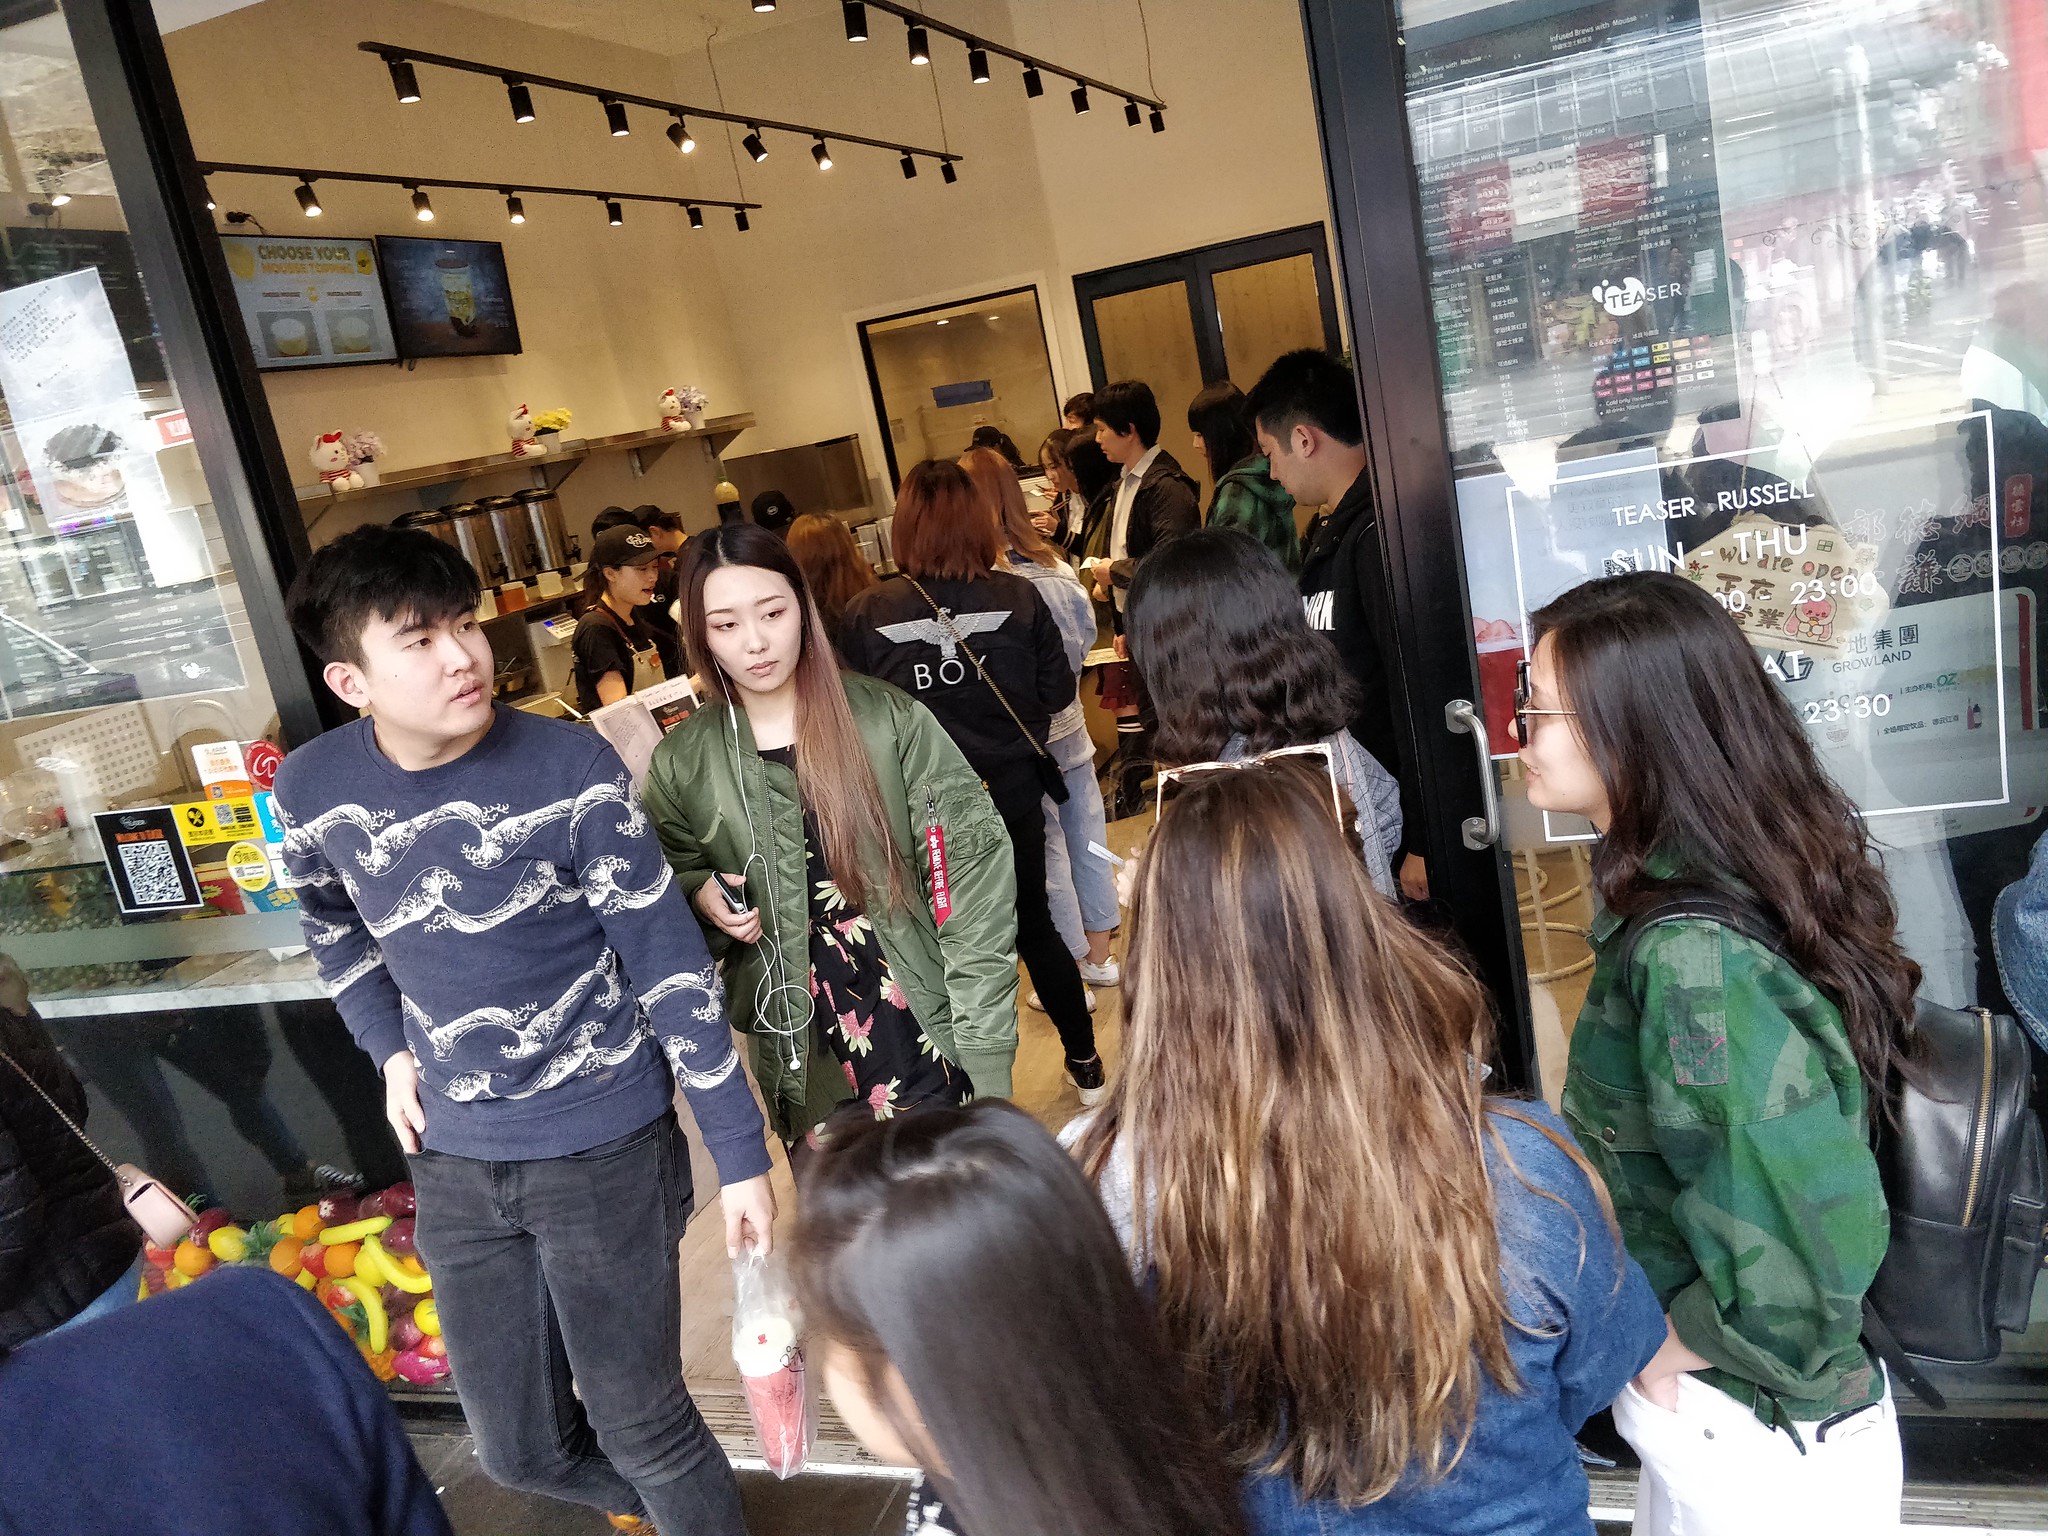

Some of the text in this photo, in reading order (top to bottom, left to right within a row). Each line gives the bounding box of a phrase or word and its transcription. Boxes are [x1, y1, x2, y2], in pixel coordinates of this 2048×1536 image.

[1574, 27, 1594, 37] Brews
[1595, 22, 1610, 31] with
[257, 244, 351, 261] CHOOSE YOUR
[1608, 282, 1682, 309] TEASER
[1612, 496, 1697, 527] TEASER
[1717, 478, 1815, 512] RUSSELL
[1611, 541, 1686, 573] SUN
[1732, 523, 1809, 562] THU
[1790, 572, 1878, 605] 23:00
[1763, 649, 1805, 682] AT
[1832, 650, 1912, 673] GROWLAND
[1804, 693, 1891, 725] 23:30
